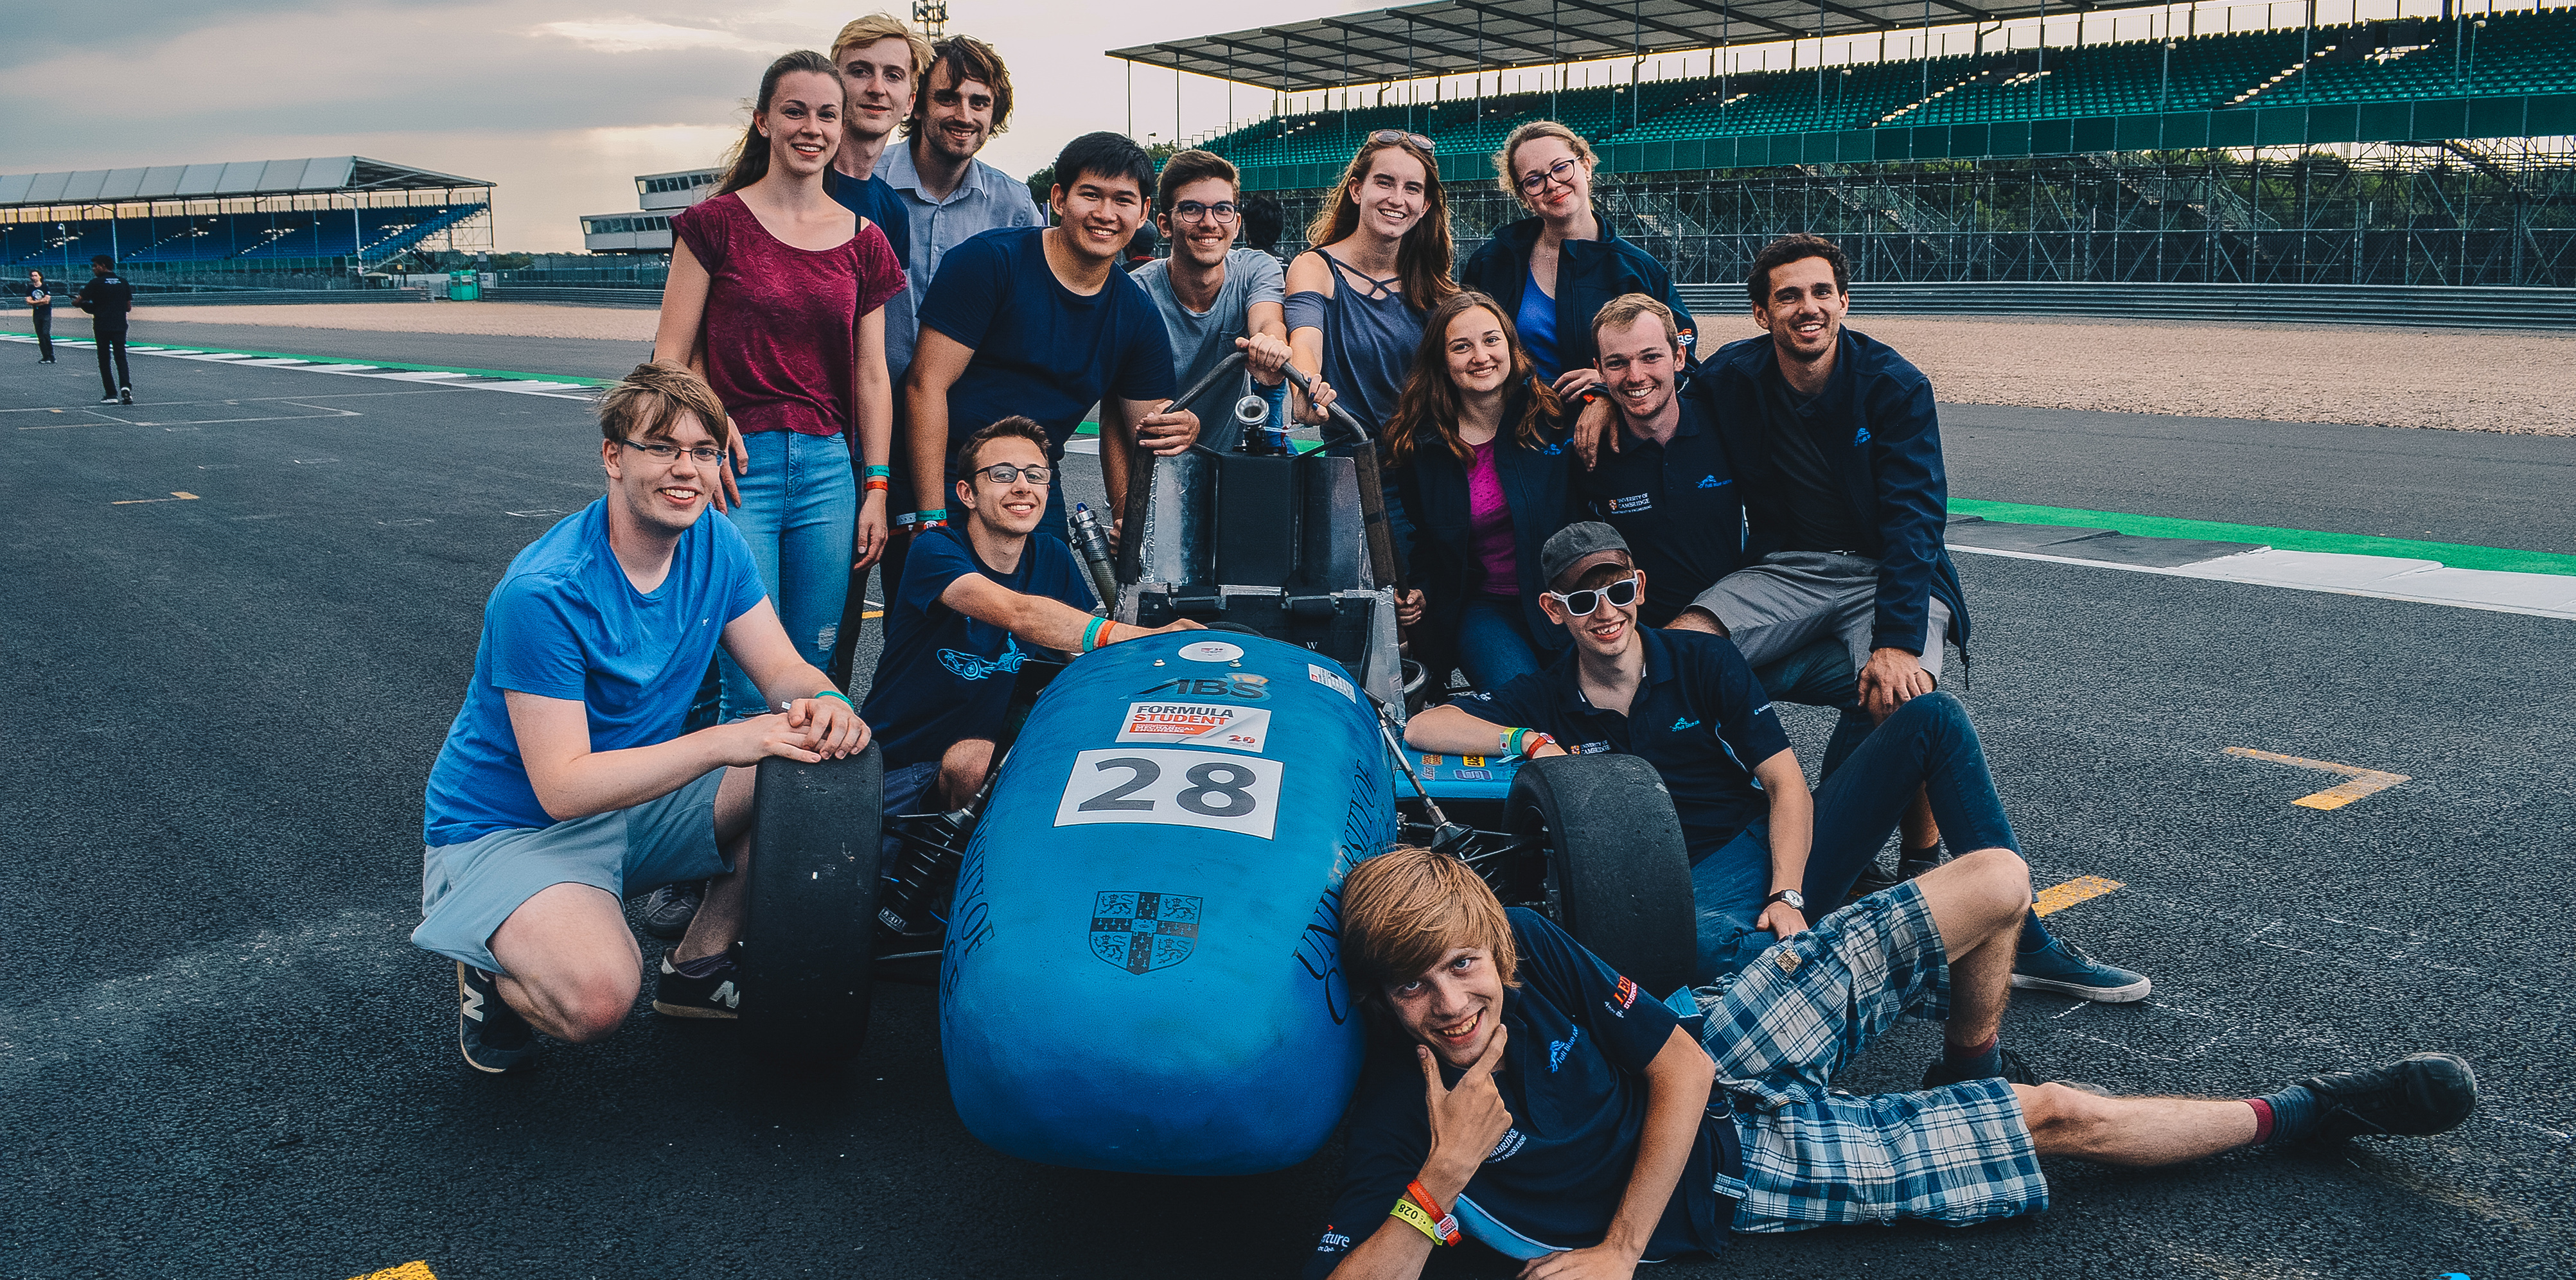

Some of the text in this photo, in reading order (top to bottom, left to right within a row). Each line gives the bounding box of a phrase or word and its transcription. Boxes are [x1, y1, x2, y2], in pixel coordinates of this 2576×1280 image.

[1618, 498, 1650, 509] CAMBRIDGE
[1136, 679, 1263, 699] ABS
[1133, 714, 1230, 725] STUDENT
[1137, 705, 1234, 717] FORMULA
[1228, 735, 1255, 744] 20
[1077, 757, 1257, 817] 28
[962, 902, 995, 960] OF
[1557, 1050, 1567, 1064] full
[1564, 1036, 1576, 1052] blue
[1490, 1128, 1519, 1158] MBRIDGE
[1416, 1187, 1438, 1214] Team Access
[1398, 1204, 1418, 1220] 028
